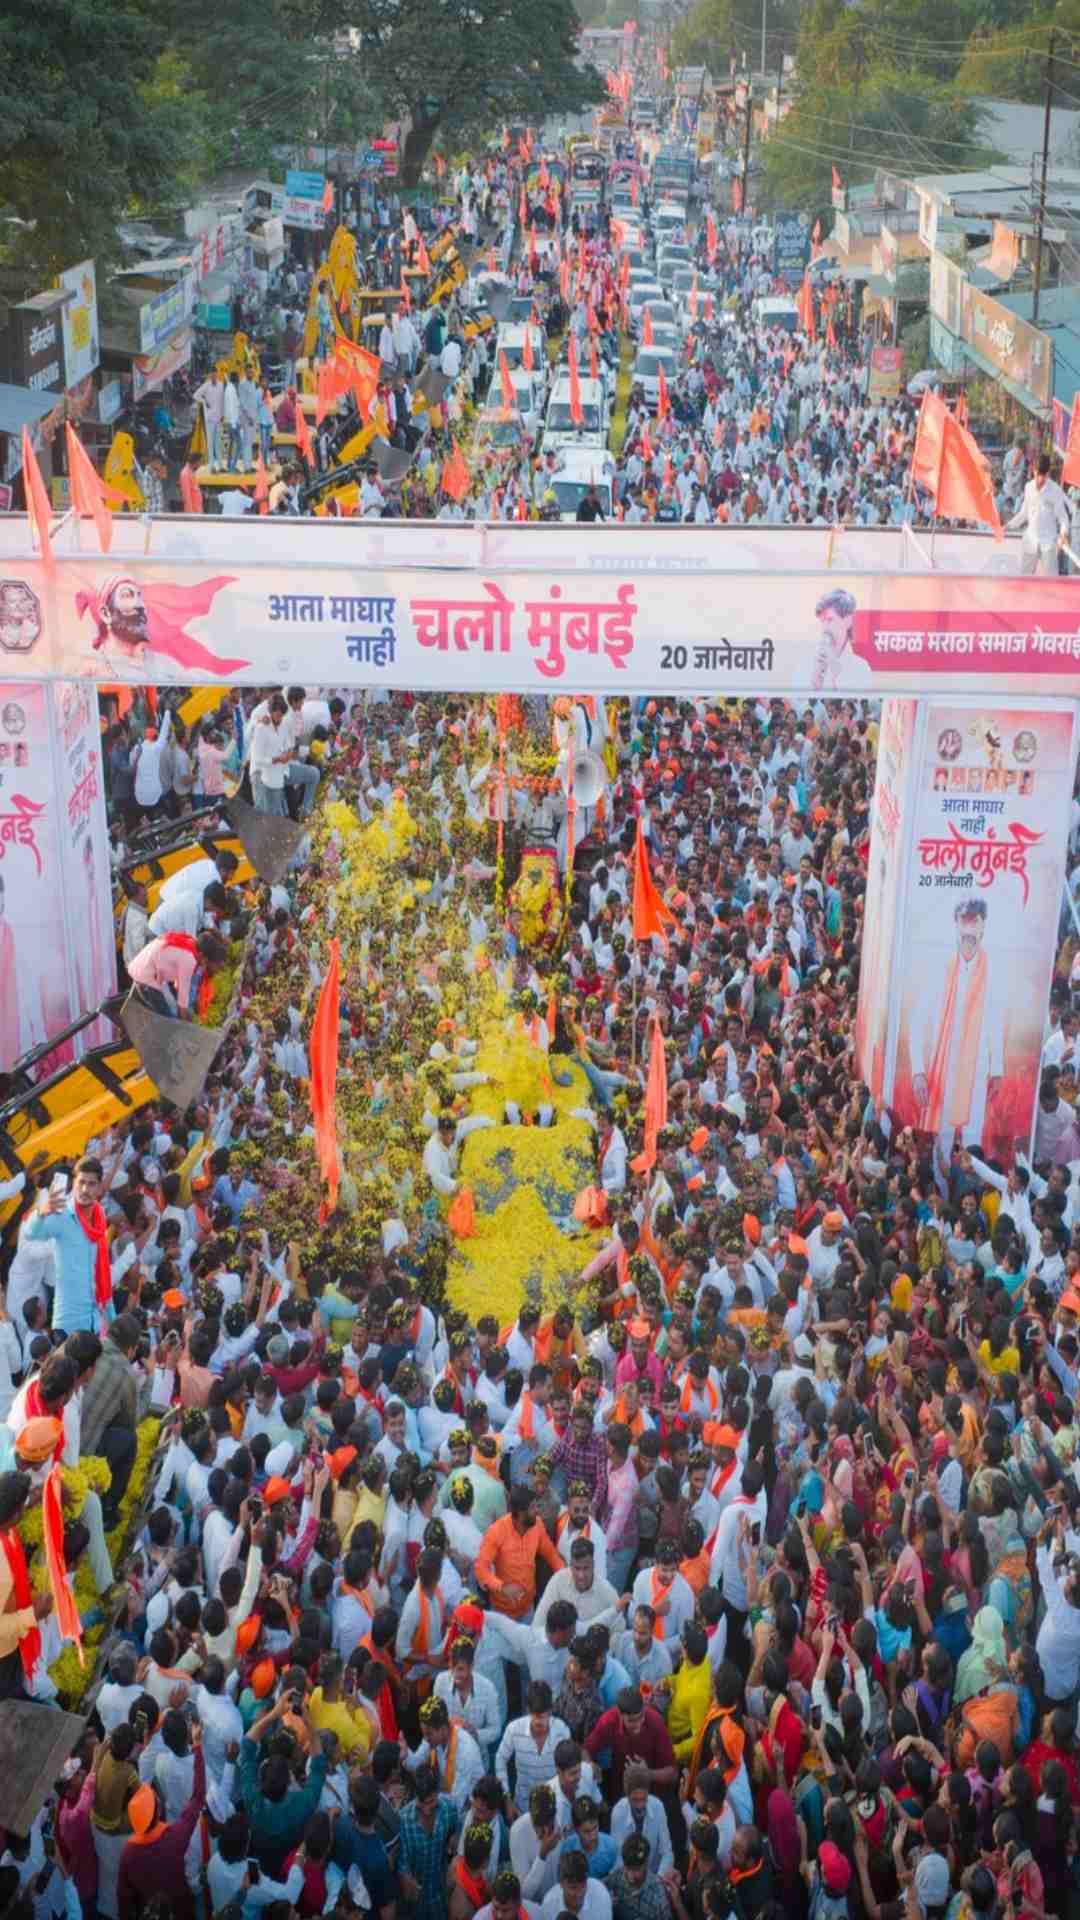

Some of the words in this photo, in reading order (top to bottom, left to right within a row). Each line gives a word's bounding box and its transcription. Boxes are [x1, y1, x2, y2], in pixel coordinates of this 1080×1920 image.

[269, 595, 324, 621] आता
[329, 596, 396, 623] माघार
[410, 582, 515, 652] चलो
[525, 584, 637, 678] मुंबई
[927, 631, 974, 654] मराठा
[978, 631, 1028, 654] समाज
[345, 627, 396, 667] नाही
[660, 645, 688, 669] 20
[693, 637, 775, 671] जानेवारी
[942, 799, 968, 812] आता
[972, 800, 1005, 814] माघार
[960, 815, 986, 833] नाही
[934, 872, 974, 888] जानेवारी
